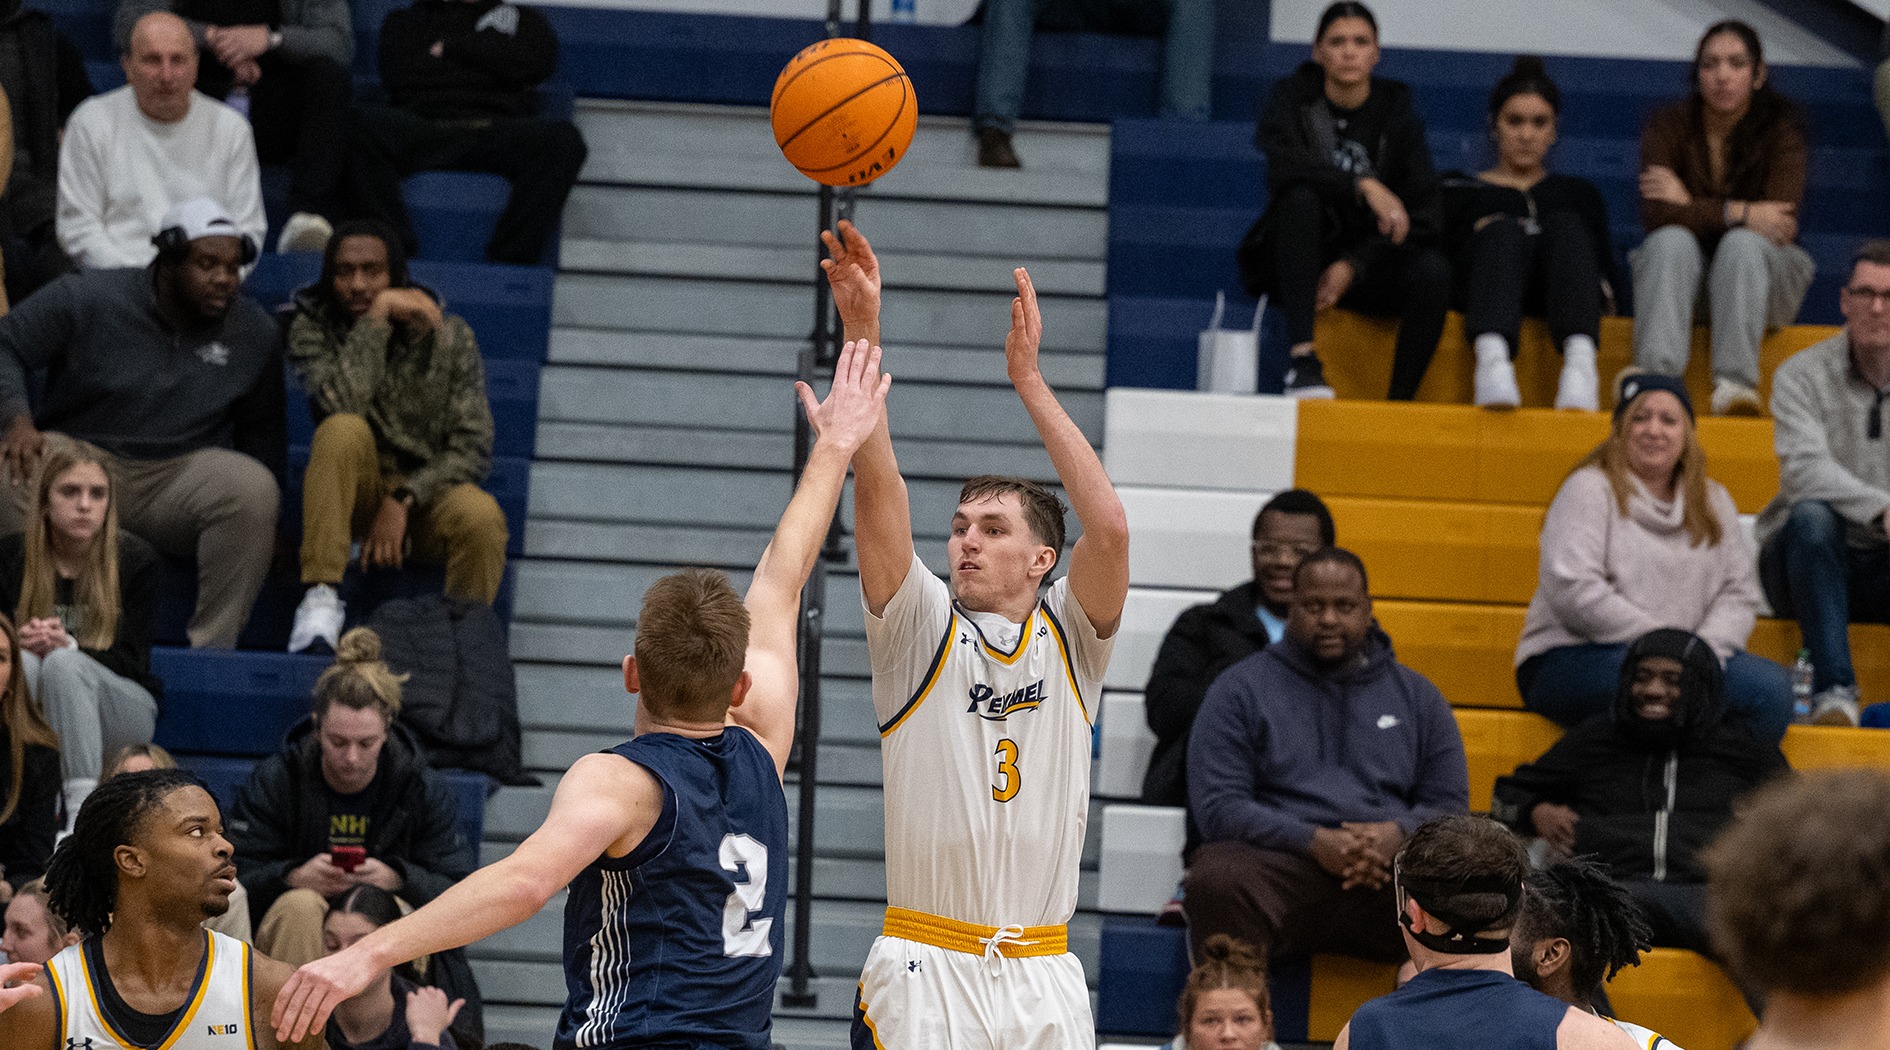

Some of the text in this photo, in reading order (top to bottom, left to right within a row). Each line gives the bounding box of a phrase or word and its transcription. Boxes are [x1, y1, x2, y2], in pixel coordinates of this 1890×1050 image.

[991, 738, 1021, 803] 3
[718, 833, 773, 957] 2
[207, 1024, 238, 1036] NE10
